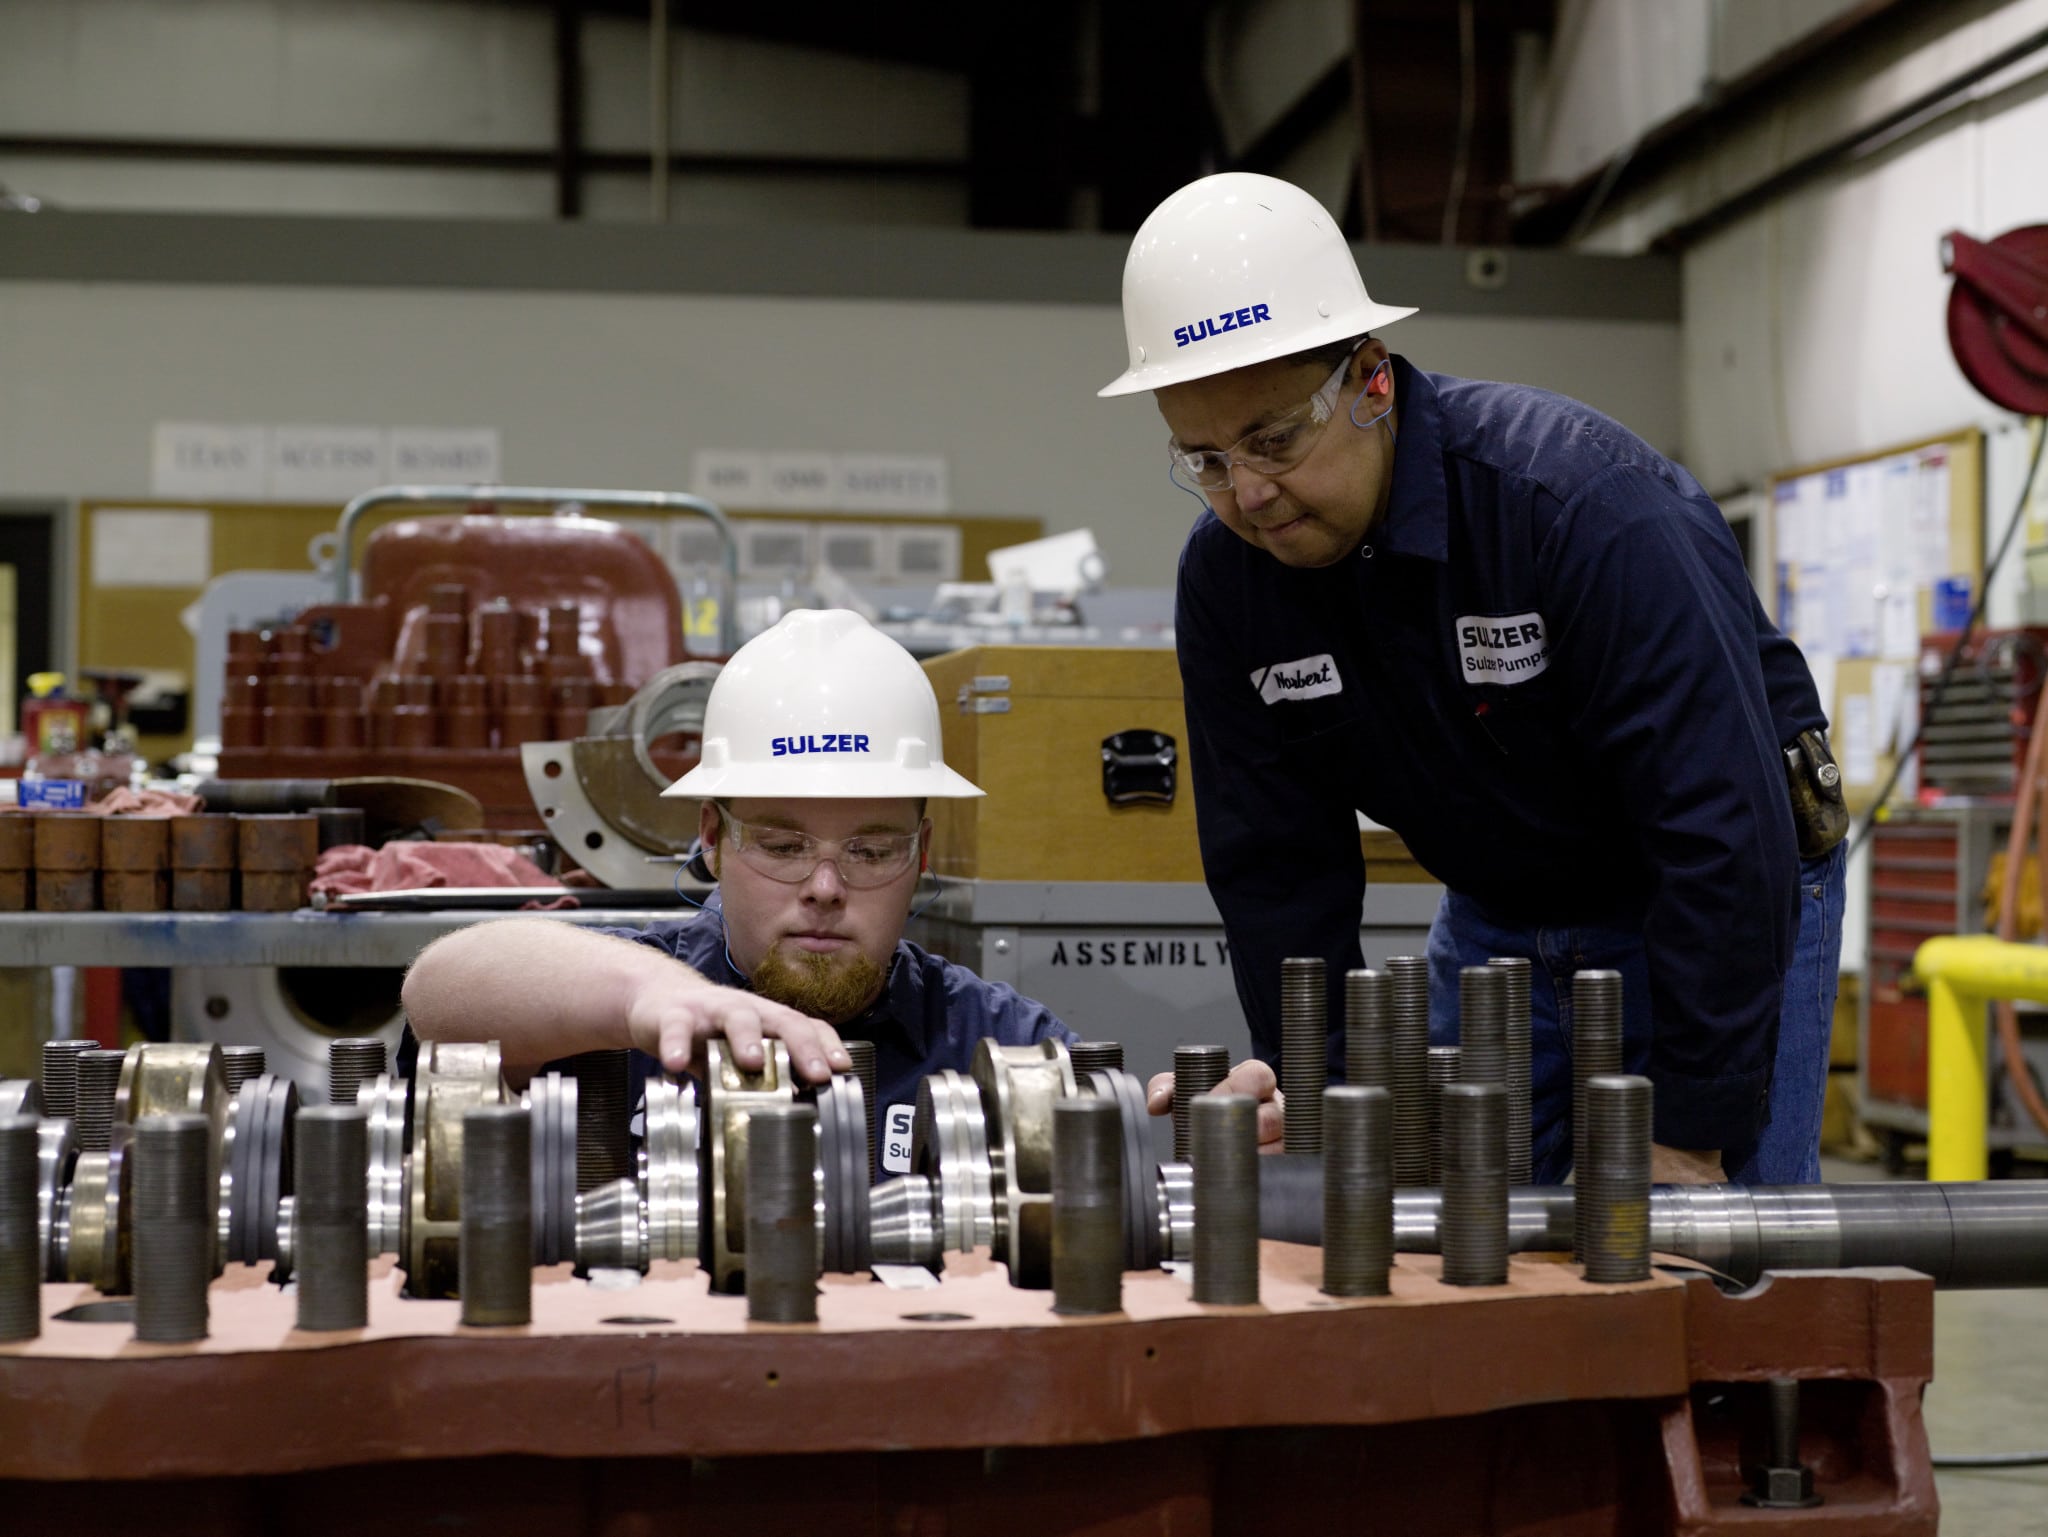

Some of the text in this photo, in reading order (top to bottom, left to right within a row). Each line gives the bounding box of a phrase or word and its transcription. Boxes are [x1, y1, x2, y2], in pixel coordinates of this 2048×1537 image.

[1173, 303, 1272, 348] SULZER
[1462, 622, 1542, 648] SULZER
[1273, 662, 1332, 689] Norbert
[771, 734, 871, 757] SULZER
[1051, 940, 1229, 967] ASSEMBLY
